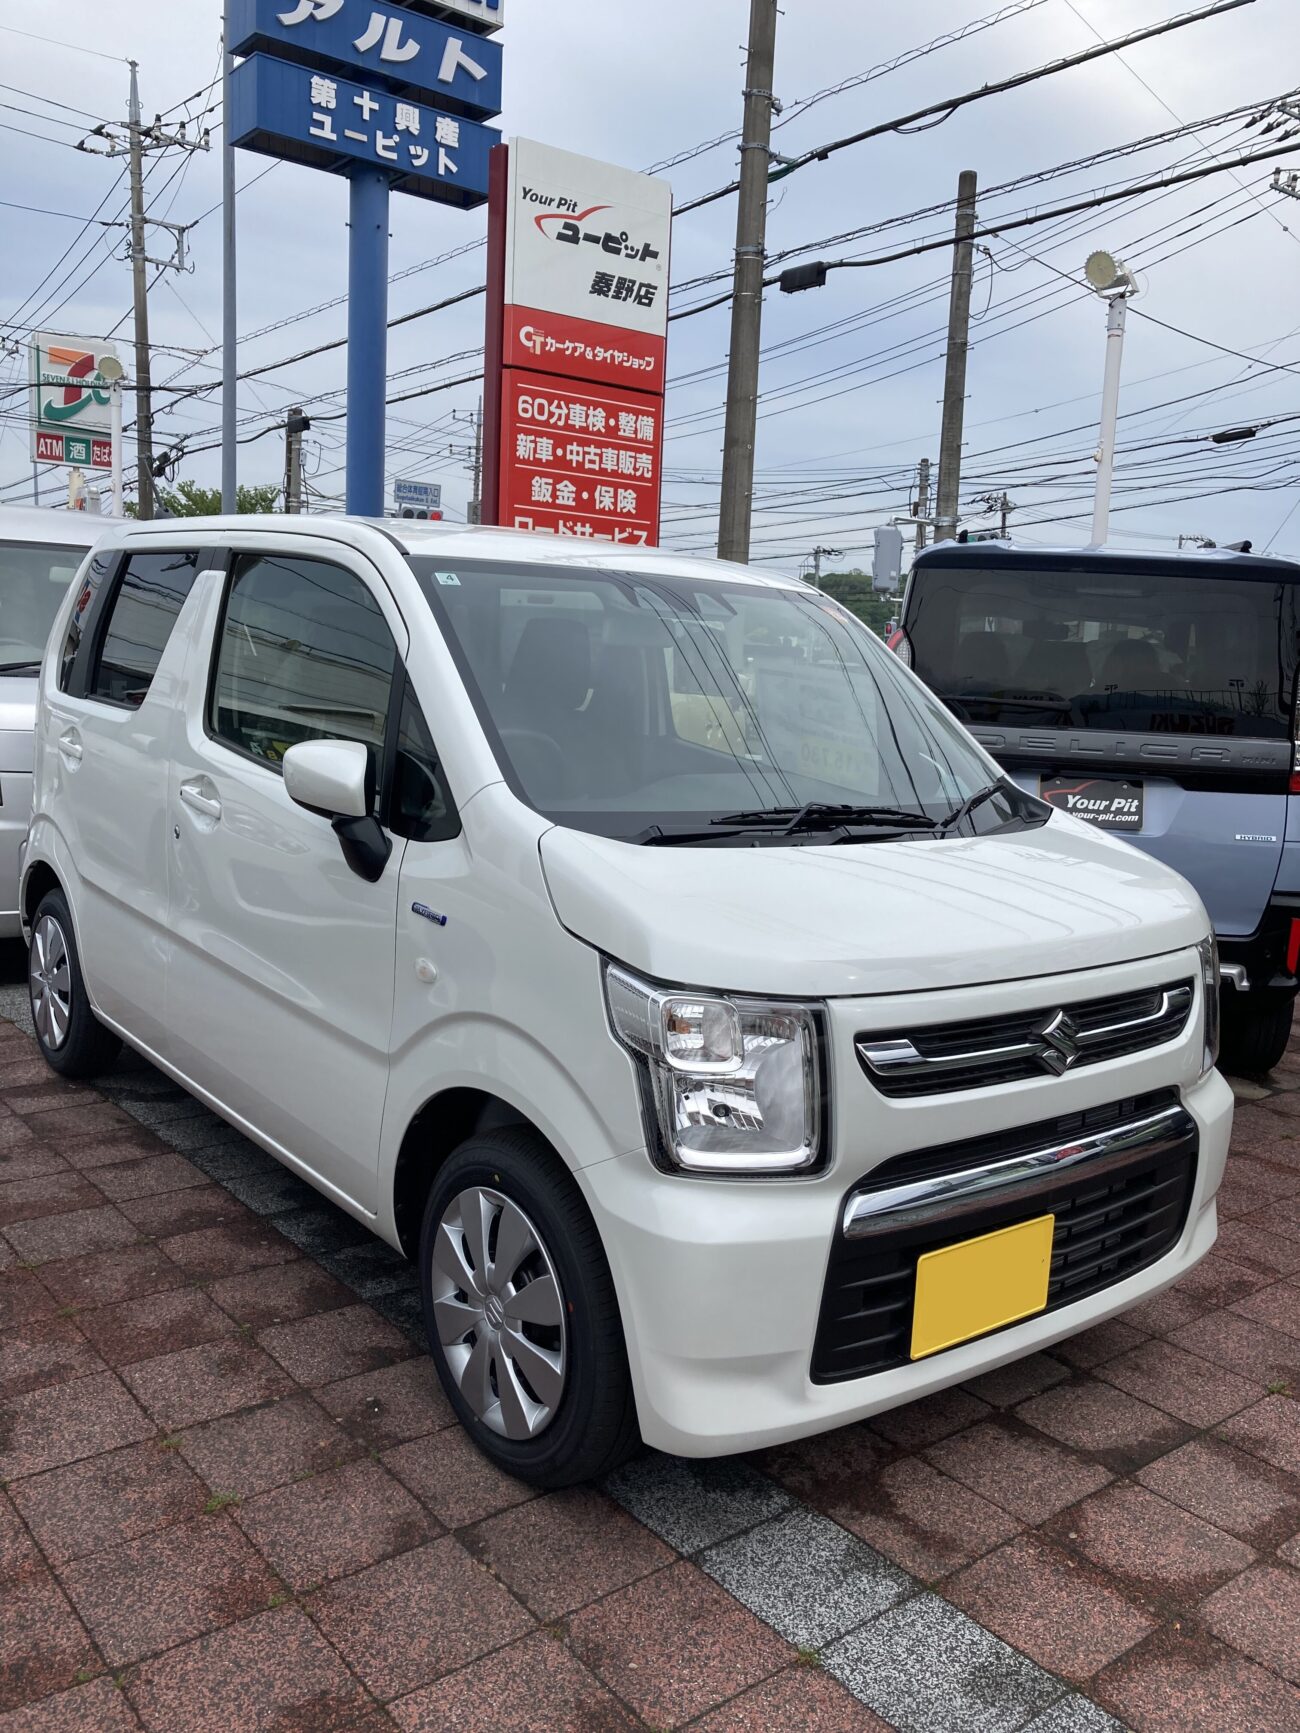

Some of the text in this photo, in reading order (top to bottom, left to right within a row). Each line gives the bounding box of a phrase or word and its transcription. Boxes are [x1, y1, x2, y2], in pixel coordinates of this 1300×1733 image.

[310, 75, 460, 149] 第十興産
[309, 111, 458, 176] ユーピット
[522, 186, 579, 214] Your Pit
[556, 221, 660, 263] ユーピット
[589, 271, 658, 308] 秦野店
[517, 395, 654, 442] 60分車検・整備
[38, 437, 63, 457] ATM
[69, 441, 86, 460] 酒
[92, 445, 112, 462] たば
[516, 433, 653, 479] 新車・中古車販売
[531, 476, 637, 515] 鈑金・保険
[1066, 794, 1139, 812] Your Pit
[1066, 811, 1139, 822] your-pit.com
